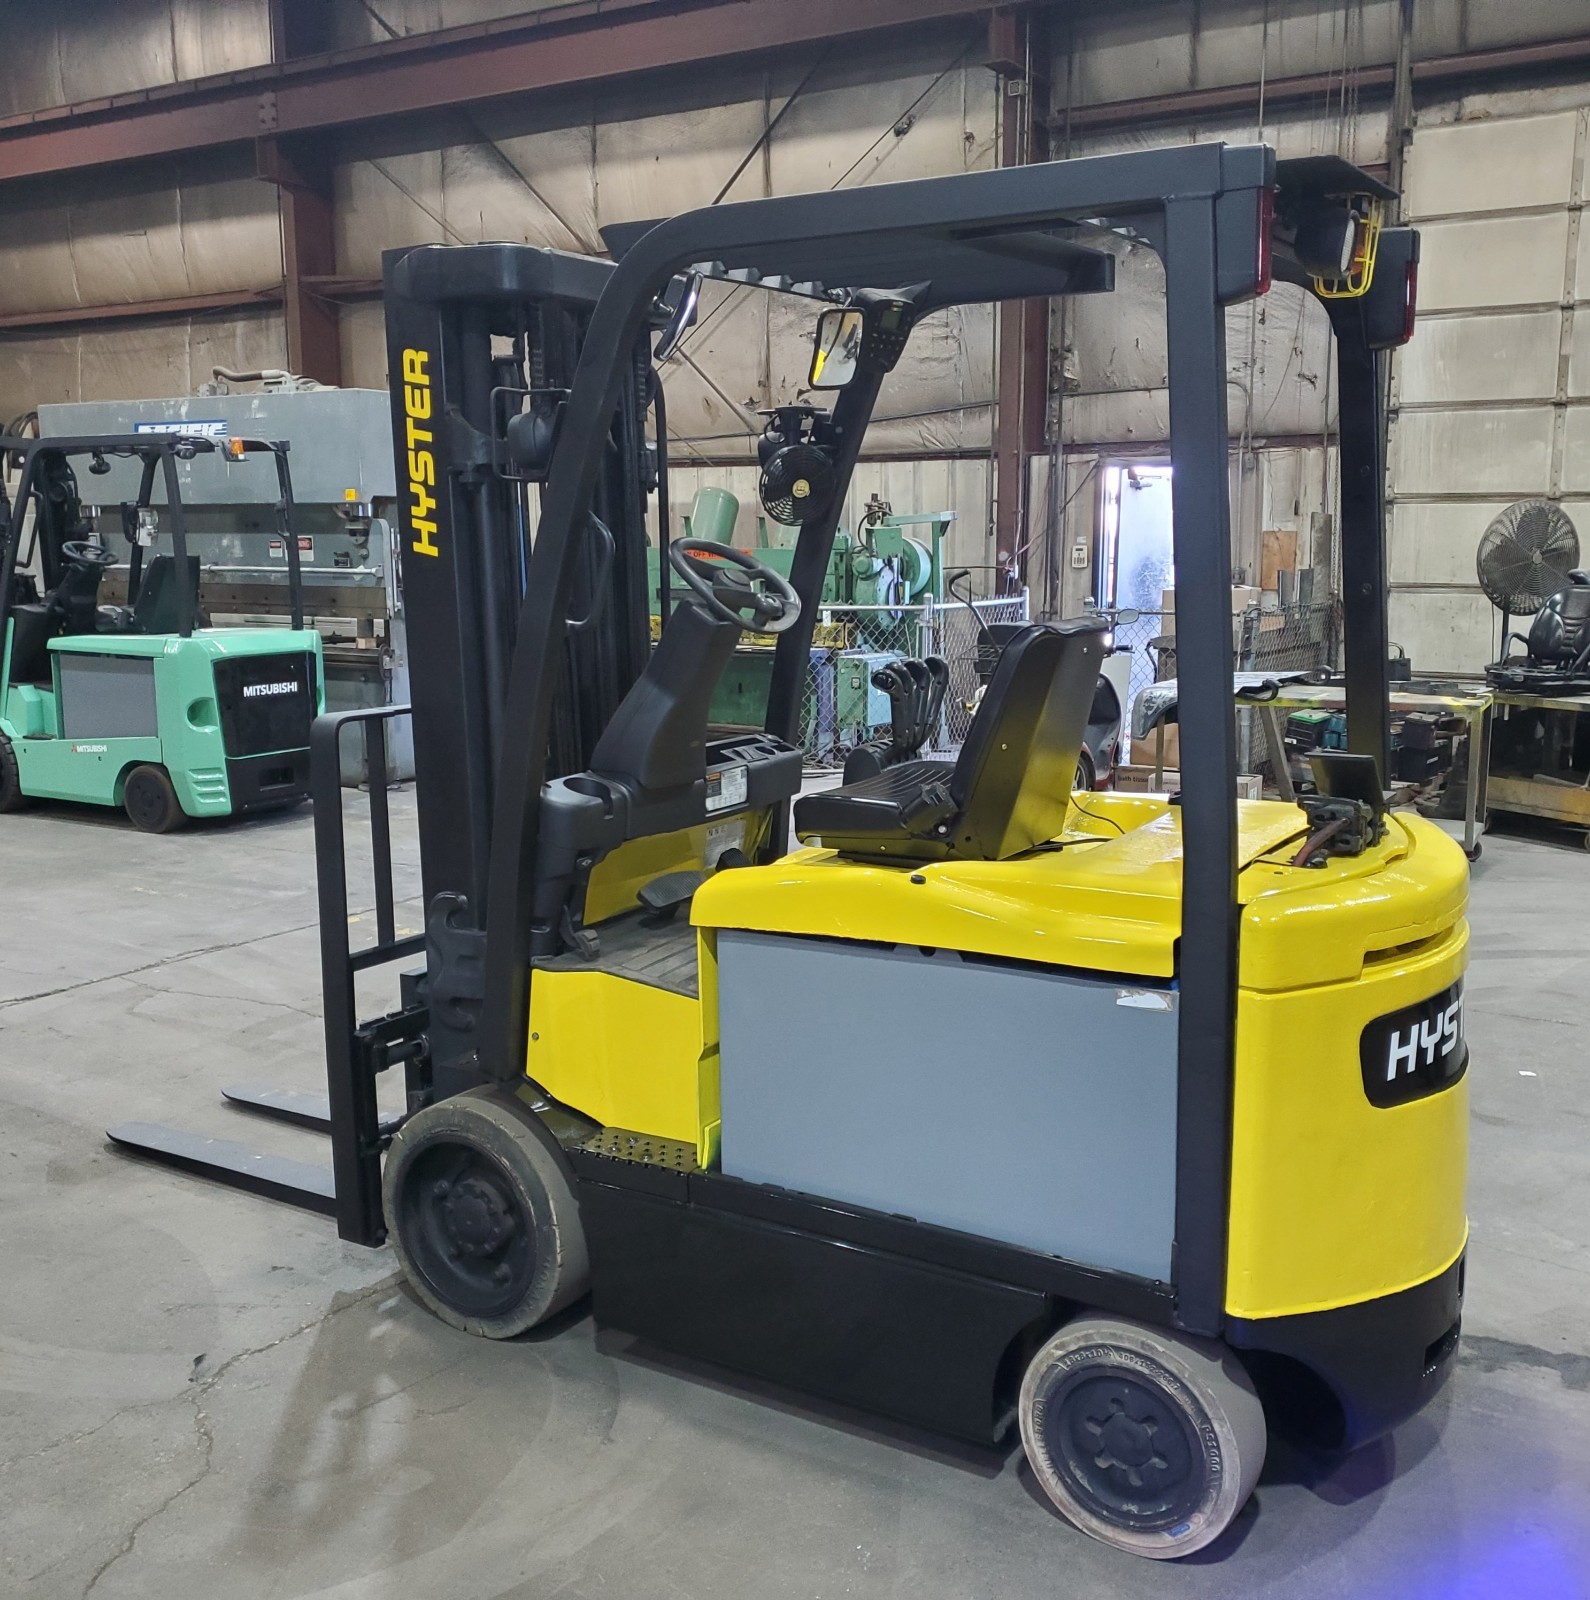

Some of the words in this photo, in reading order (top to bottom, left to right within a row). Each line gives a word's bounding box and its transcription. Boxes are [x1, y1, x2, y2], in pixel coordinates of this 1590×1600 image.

[402, 348, 439, 557] HYSTER
[243, 681, 298, 697] MITSUBISHI
[76, 744, 107, 753] MITSUBISHI
